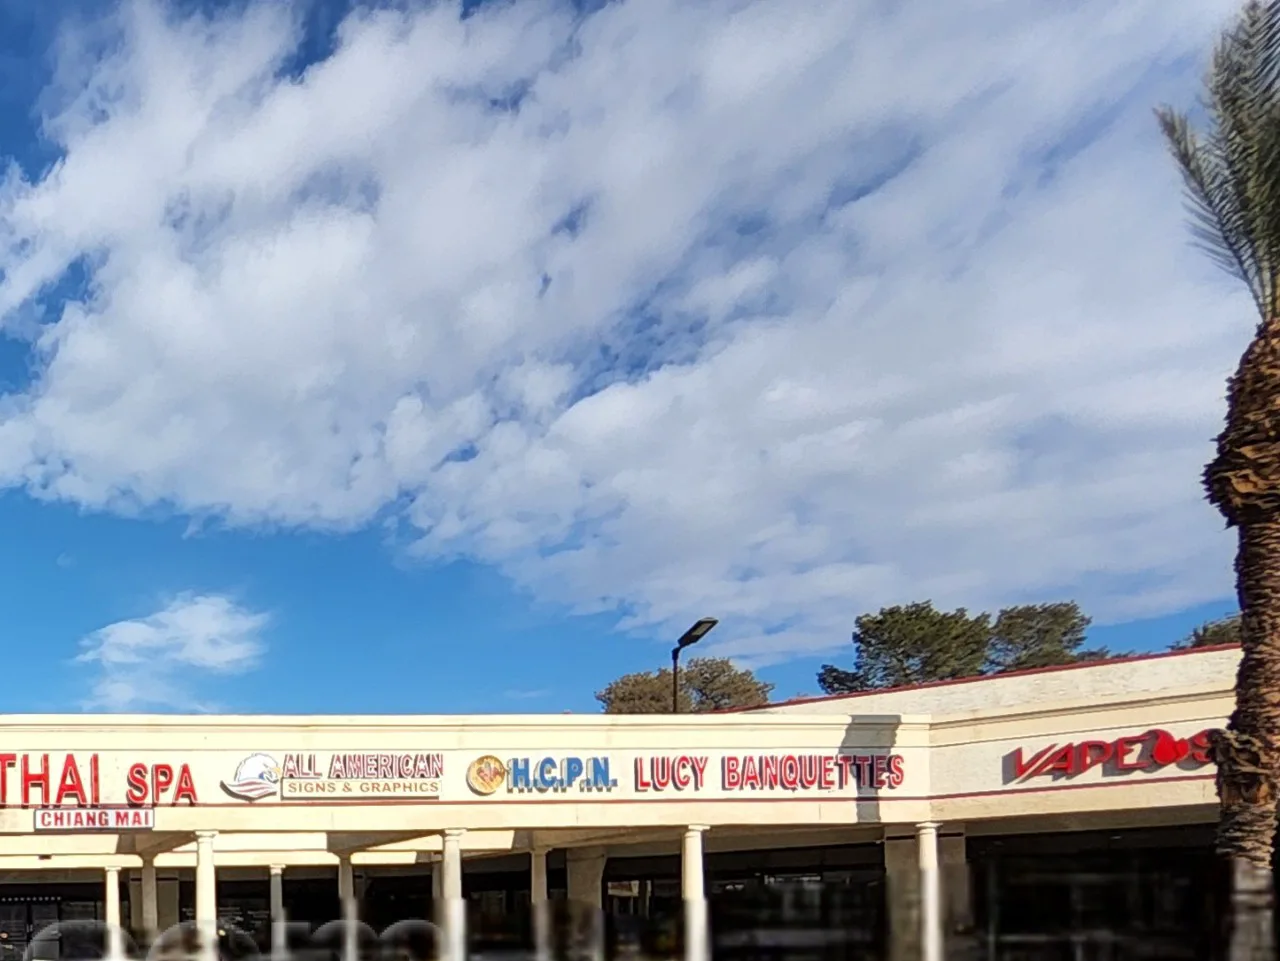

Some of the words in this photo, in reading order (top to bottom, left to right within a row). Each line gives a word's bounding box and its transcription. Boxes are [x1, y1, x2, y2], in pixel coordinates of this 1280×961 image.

[283, 753, 322, 778] ALL
[329, 753, 444, 778] AMERICAN
[509, 757, 618, 789] H.C.P.N.
[636, 756, 708, 790] LUCY
[725, 755, 905, 789] BANQUETTES
[126, 762, 199, 806] SPA
[288, 782, 337, 793] SIGNS
[342, 782, 352, 793] &
[359, 781, 439, 793] GRAPHICS
[41, 811, 109, 827] CHIANG
[115, 811, 150, 826] MAI
